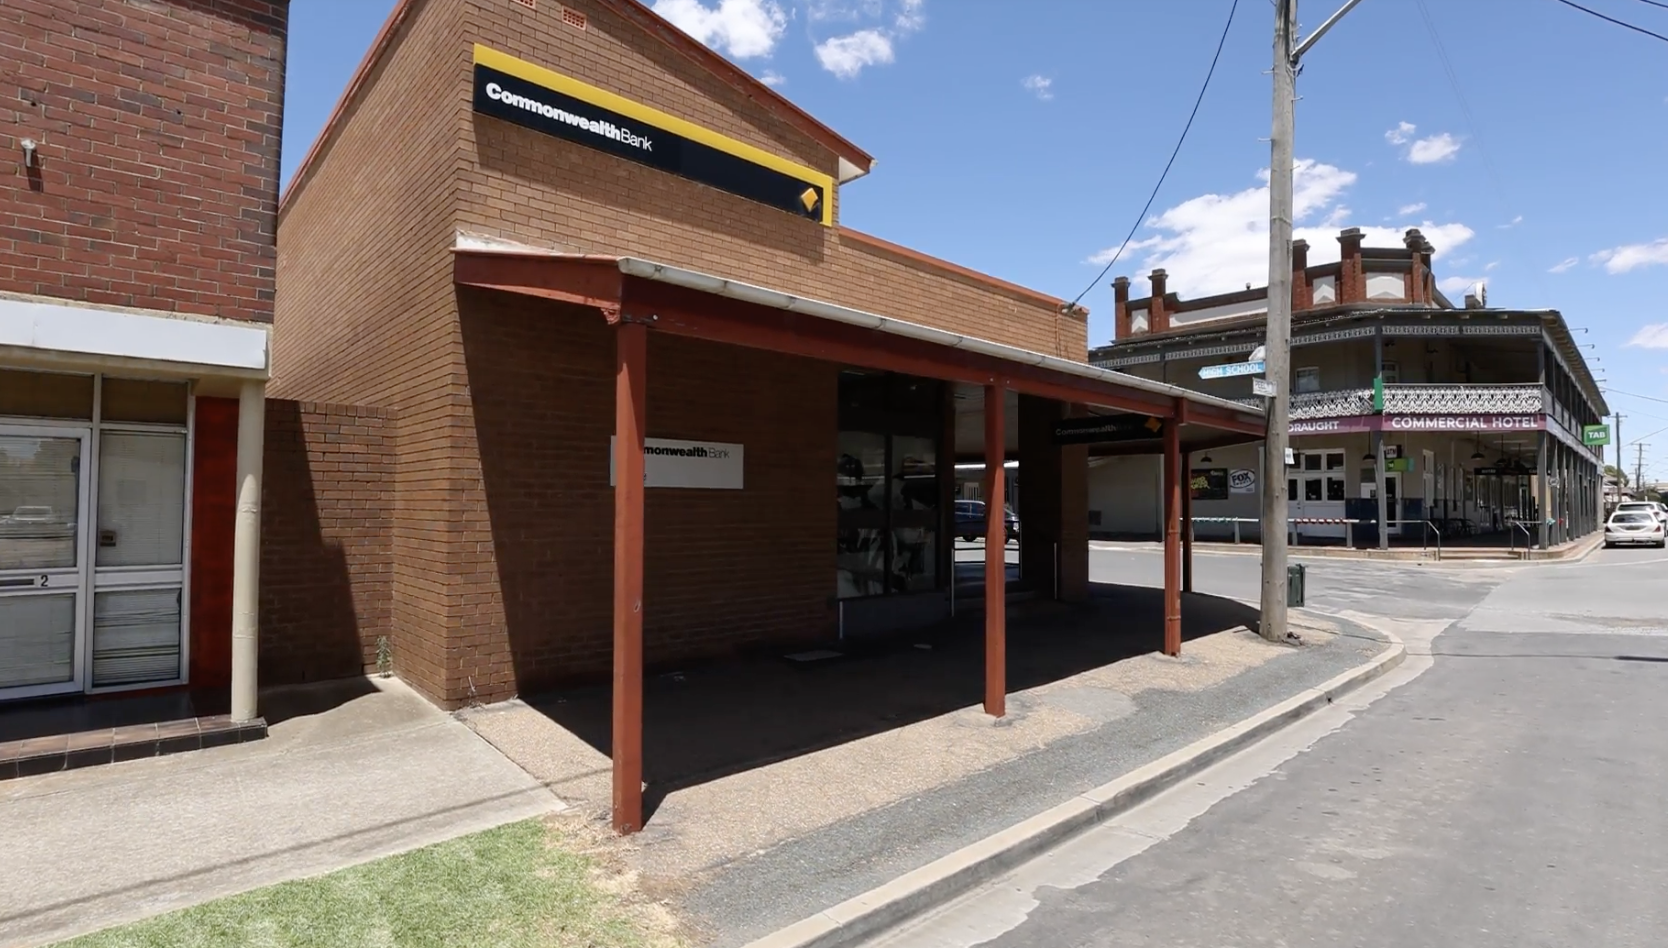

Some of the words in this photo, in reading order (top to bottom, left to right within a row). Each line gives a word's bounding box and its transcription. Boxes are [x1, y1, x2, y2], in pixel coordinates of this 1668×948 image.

[485, 82, 652, 151] CommonwealthBank
[1203, 367, 1222, 377] HIGH
[1225, 363, 1261, 375] SCHOOL
[1391, 416, 1487, 429] COMMERCIAL
[1492, 416, 1538, 428] HOTEL
[1588, 431, 1606, 439] TAB
[643, 446, 730, 459] monwealthBank
[1232, 471, 1252, 484] FOX
[40, 574, 49, 587] 2
